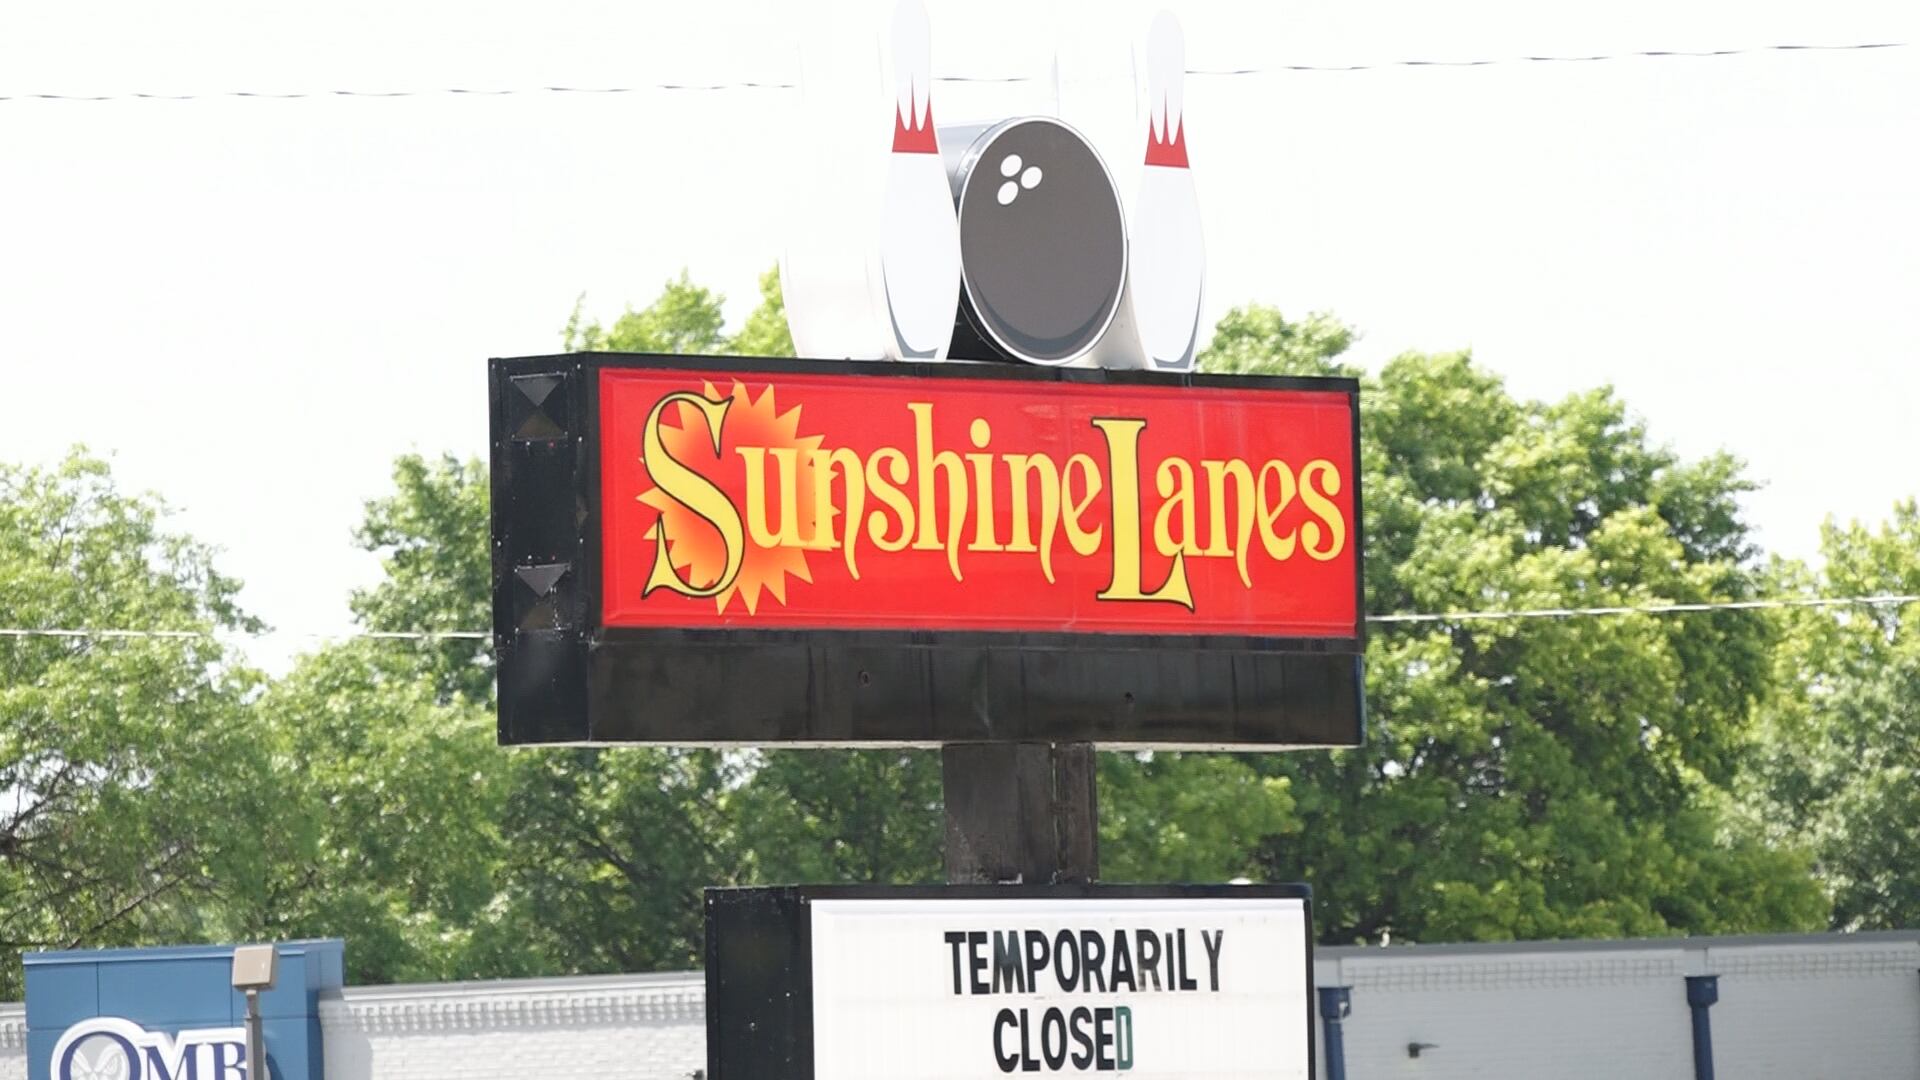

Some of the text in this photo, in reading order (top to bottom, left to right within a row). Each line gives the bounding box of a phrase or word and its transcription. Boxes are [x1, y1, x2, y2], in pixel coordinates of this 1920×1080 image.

[641, 392, 1346, 612] Sunshine Lanes
[944, 929, 1223, 995] TEMPORARILY
[993, 1005, 1133, 1074] CLOSED
